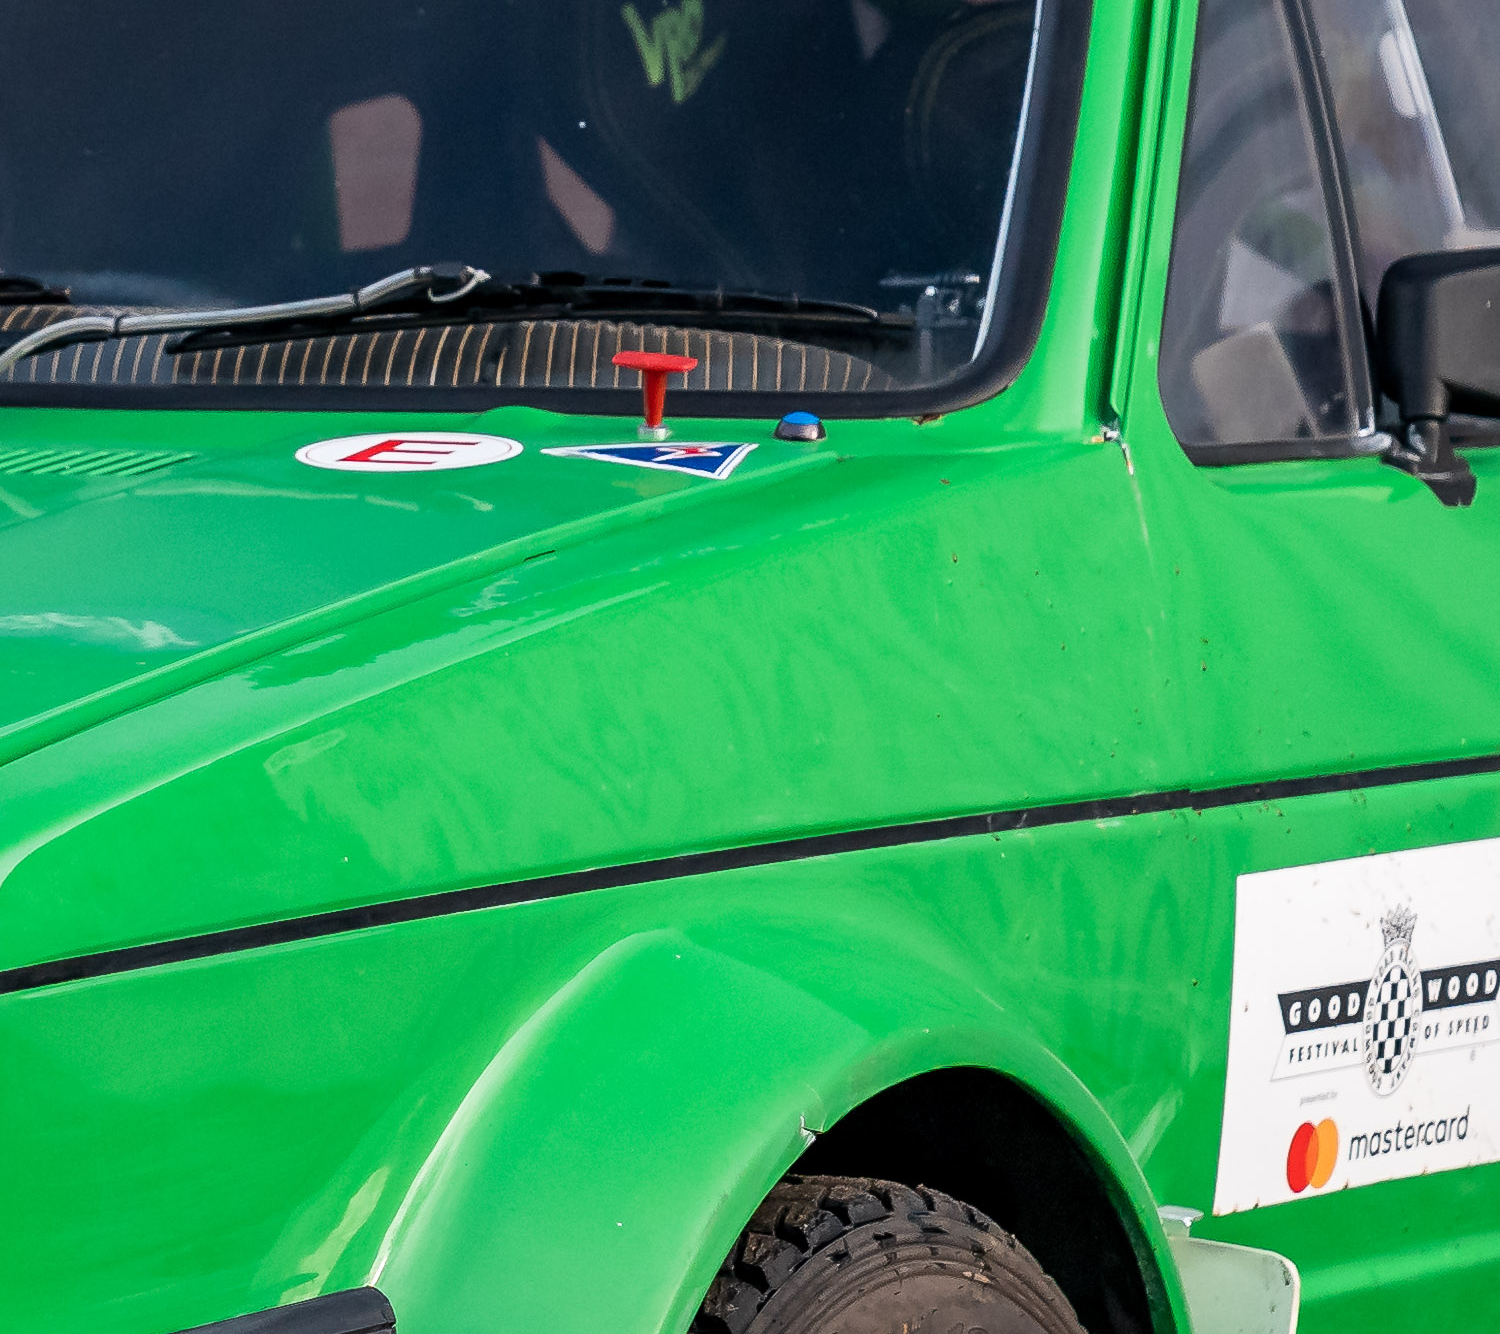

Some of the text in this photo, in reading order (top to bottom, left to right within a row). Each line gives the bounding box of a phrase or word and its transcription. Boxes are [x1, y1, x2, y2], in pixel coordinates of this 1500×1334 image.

[336, 439, 482, 465] E
[1289, 993, 1361, 1026] GOOD
[1289, 1015, 1490, 1063] FESTIVAL OF SPEED
[1348, 1105, 1471, 1161] mastercard
